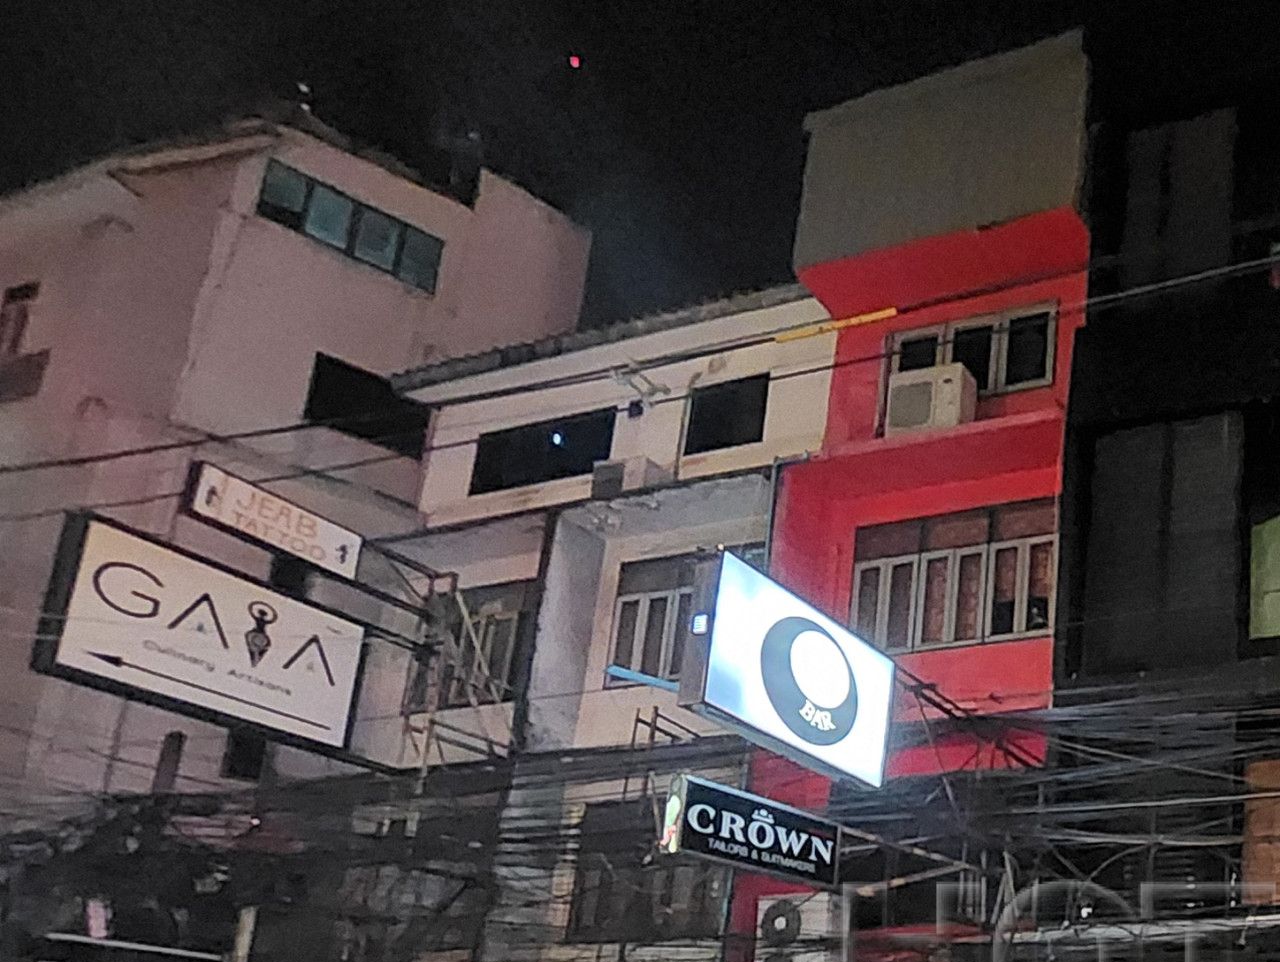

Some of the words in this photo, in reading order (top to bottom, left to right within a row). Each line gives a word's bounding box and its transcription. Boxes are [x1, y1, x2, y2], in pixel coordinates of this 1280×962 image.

[799, 699, 836, 731] BAR
[687, 804, 834, 865] CROWN
[708, 838, 749, 858] TAILORS
[751, 849, 758, 860] &
